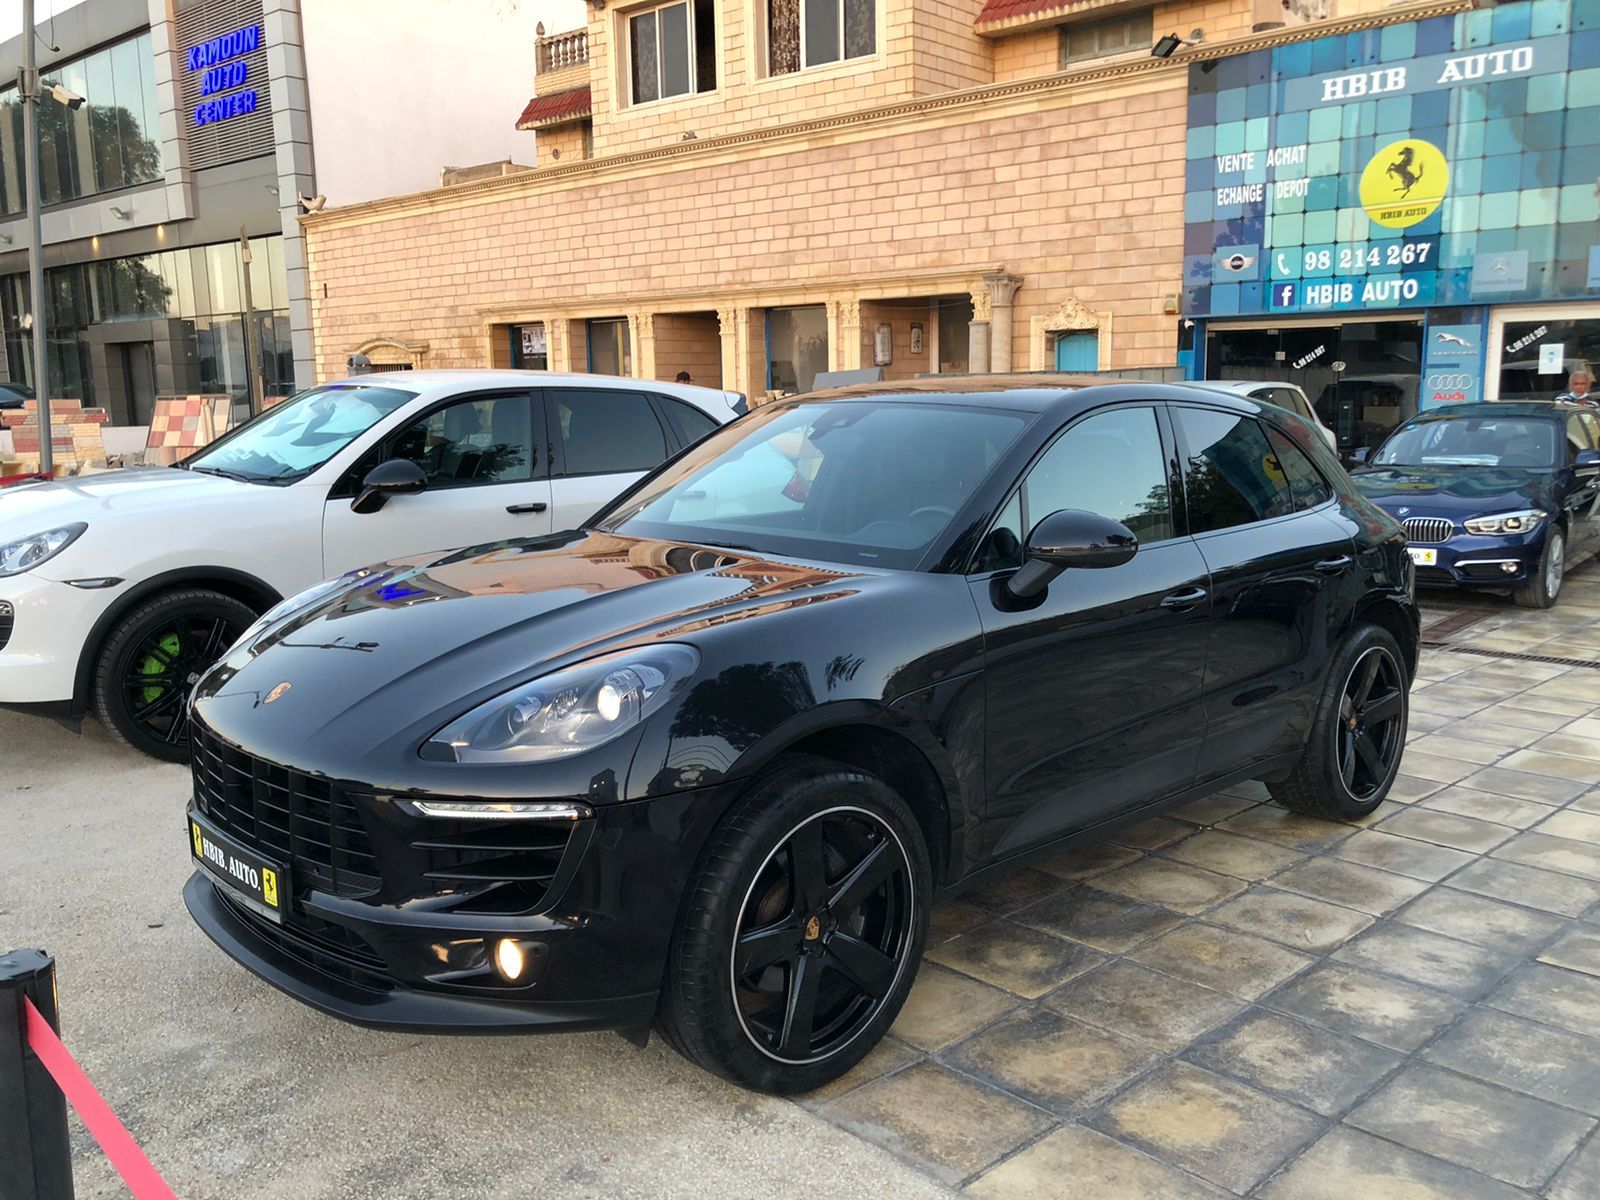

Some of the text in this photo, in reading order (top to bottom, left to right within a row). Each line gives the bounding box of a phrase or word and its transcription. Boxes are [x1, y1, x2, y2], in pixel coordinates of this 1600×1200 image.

[187, 24, 260, 72] KAMOUN
[201, 61, 247, 96] AUTO
[1321, 47, 1533, 101] HBIB AUTO
[194, 90, 257, 126] CENTER
[1217, 145, 1307, 174] VENTE ACHAT
[1217, 178, 1310, 206] ECHANGE DEPOT
[1380, 207, 1427, 220] HBIB AUTO
[1305, 243, 1431, 271] 98 214 267
[1306, 279, 1418, 305] HBIB AUTO
[1432, 391, 1466, 401] Audi
